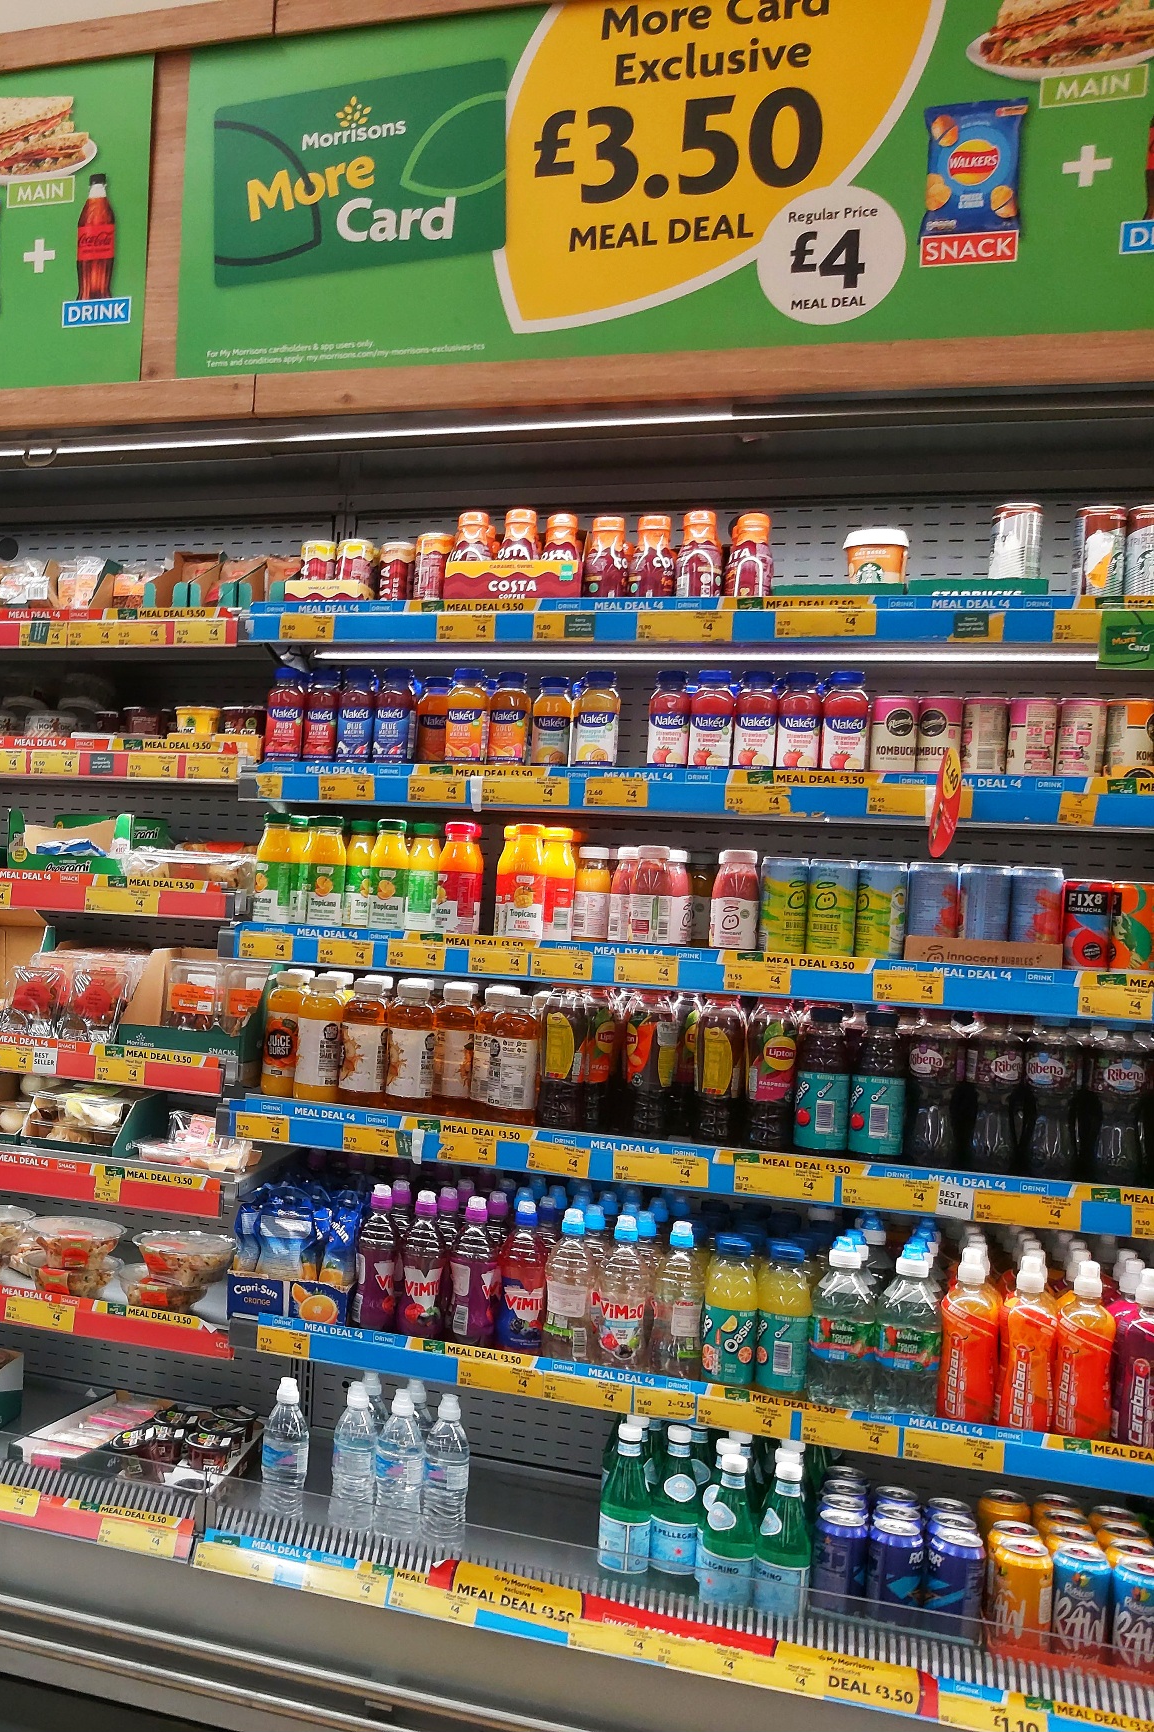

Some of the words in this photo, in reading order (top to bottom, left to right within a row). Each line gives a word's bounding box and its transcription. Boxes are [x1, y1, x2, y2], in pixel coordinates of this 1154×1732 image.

[601, 3, 710, 41] More
[615, 38, 811, 86] Exclusive
[1056, 74, 1131, 101] MAIN
[302, 120, 406, 151] Morrisons
[534, 87, 823, 204] £3.50
[949, 155, 998, 169] WALKERS
[17, 183, 64, 202] MAIN
[247, 155, 375, 222] More
[336, 197, 456, 242] Card
[789, 207, 840, 225] Regular
[844, 206, 878, 219] Price
[569, 221, 657, 252] MEAL
[669, 213, 753, 245] DEAL
[926, 238, 1013, 261] SNACK
[791, 229, 865, 289] £4
[791, 298, 827, 310] MEAL
[831, 296, 866, 308] DEAL
[68, 302, 126, 322] DRINK
[488, 580, 537, 593] COSTA
[447, 602, 471, 611] MEAL
[475, 602, 499, 611] DEAL
[502, 602, 524, 611] £3.50
[932, 599, 962, 609] MEAL
[965, 599, 996, 609] DEAL
[999, 599, 1010, 608] £4
[271, 709, 298, 719] Naked
[342, 708, 369, 718] Naked
[448, 709, 475, 721] Naked
[580, 713, 608, 725] Naked
[654, 715, 684, 727] Naked
[695, 716, 725, 728] Naked
[740, 715, 771, 728] Naked
[785, 717, 816, 729] Naked
[832, 718, 864, 730] Naked
[145, 742, 166, 750] MEAL
[169, 742, 190, 751] DEAL
[192, 742, 211, 750] £3.50
[776, 774, 805, 784] MEAL
[808, 774, 836, 785] DEAL
[840, 775, 864, 785] £3.50
[1068, 893, 1103, 907] FIX8
[509, 908, 537, 919] Tropicana
[946, 951, 999, 963] innocent
[1002, 956, 1033, 966] BUBBLES
[127, 1040, 154, 1048] Morrisons
[269, 1044, 289, 1056] BURST
[208, 1048, 237, 1057] SNACKS
[769, 1048, 793, 1058] Lipton
[910, 1048, 944, 1067] Ribena
[1027, 1061, 1064, 1077] Ribena
[1107, 1067, 1144, 1082] Ribena
[443, 1124, 468, 1135] MEAL
[470, 1127, 495, 1136] DEAL
[498, 1130, 520, 1141] £3.50
[762, 1157, 792, 1168] MEAL
[795, 1161, 823, 1171] DEAL
[825, 1163, 850, 1174] £3.50
[940, 1190, 961, 1200] BEST
[939, 1198, 968, 1210] SELLER
[234, 1283, 278, 1299] Capri-Sun
[447, 1346, 471, 1357] MEAL
[474, 1351, 498, 1362] DEAL
[500, 1354, 522, 1365] £3.50
[909, 1417, 939, 1430] MEAL
[942, 1422, 969, 1434] DEAL
[972, 1426, 983, 1436] £4
[457, 1583, 495, 1605] MEAL
[501, 1595, 537, 1616] DEAL
[828, 1675, 870, 1695] DEAL
[876, 1684, 913, 1704] £3.50
[1056, 1704, 1091, 1721] MEAL
[1094, 1711, 1126, 1727] DEAL
